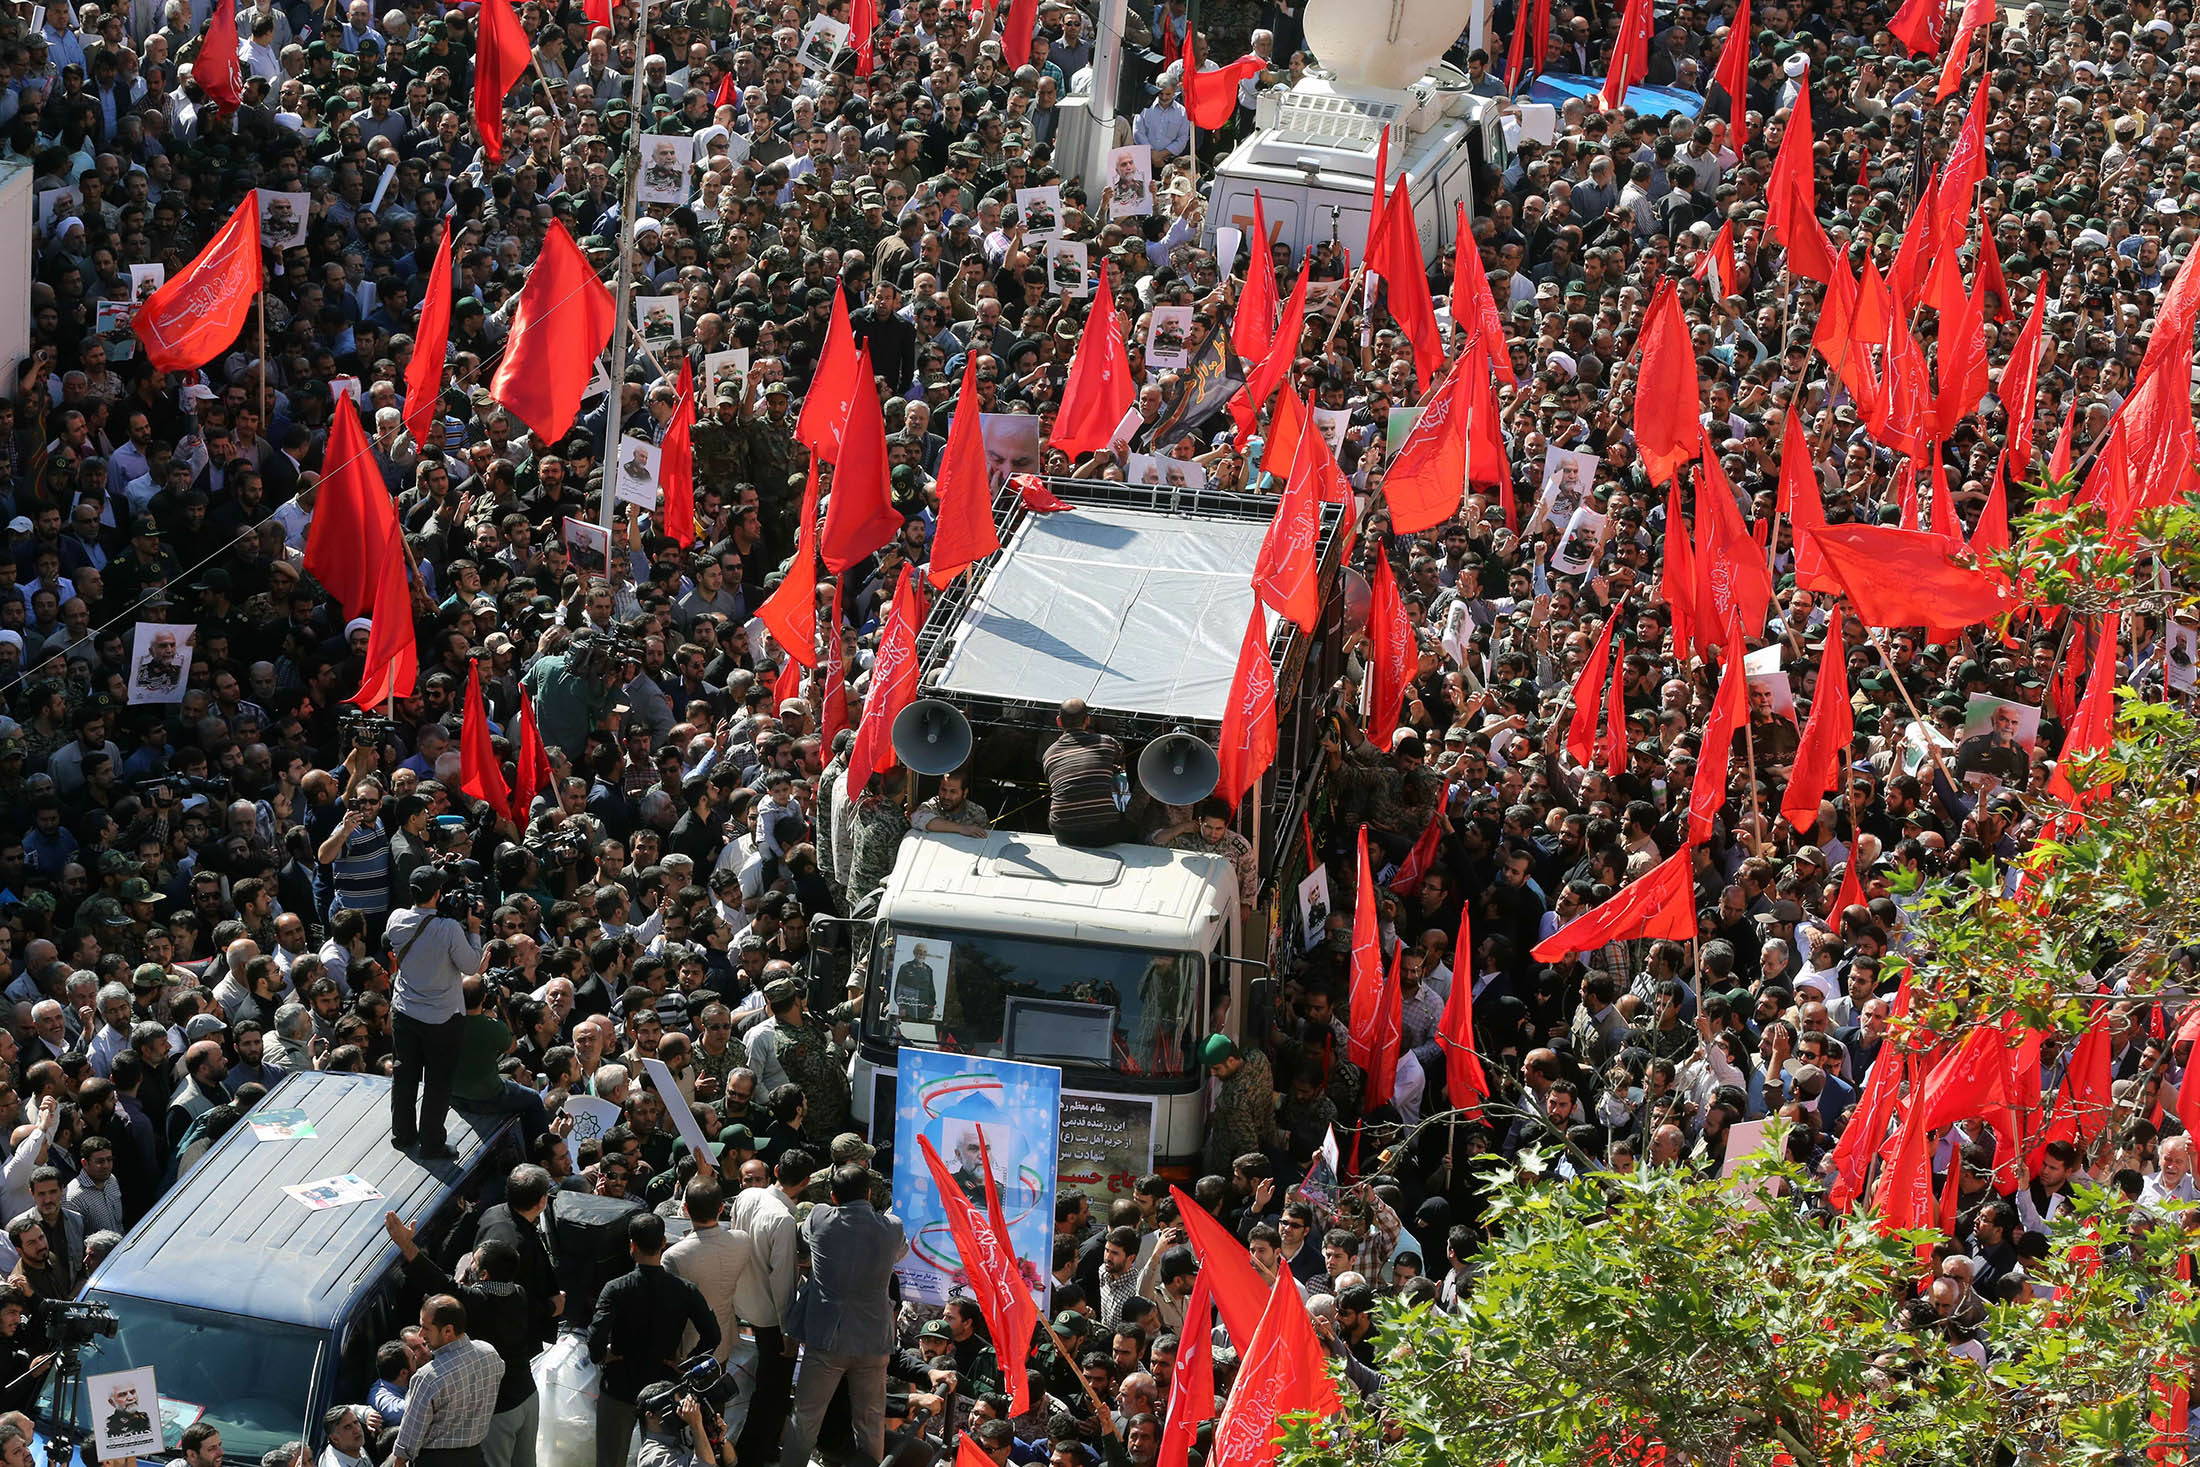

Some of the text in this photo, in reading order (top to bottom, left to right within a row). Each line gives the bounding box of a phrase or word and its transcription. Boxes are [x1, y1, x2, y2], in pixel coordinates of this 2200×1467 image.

[1069, 1101, 1089, 1111] معظم
[1090, 1103, 1106, 1114] مقام
[1061, 1116, 1126, 1132] این رزمنده قدیمی
[1060, 1131, 1074, 1143] (ع)
[1075, 1135, 1089, 1144] بیت
[1104, 1137, 1122, 1148] حریم
[1124, 1138, 1132, 1148] از
[1074, 1149, 1106, 1163] شهادت
[1107, 1170, 1137, 1193] حاج
